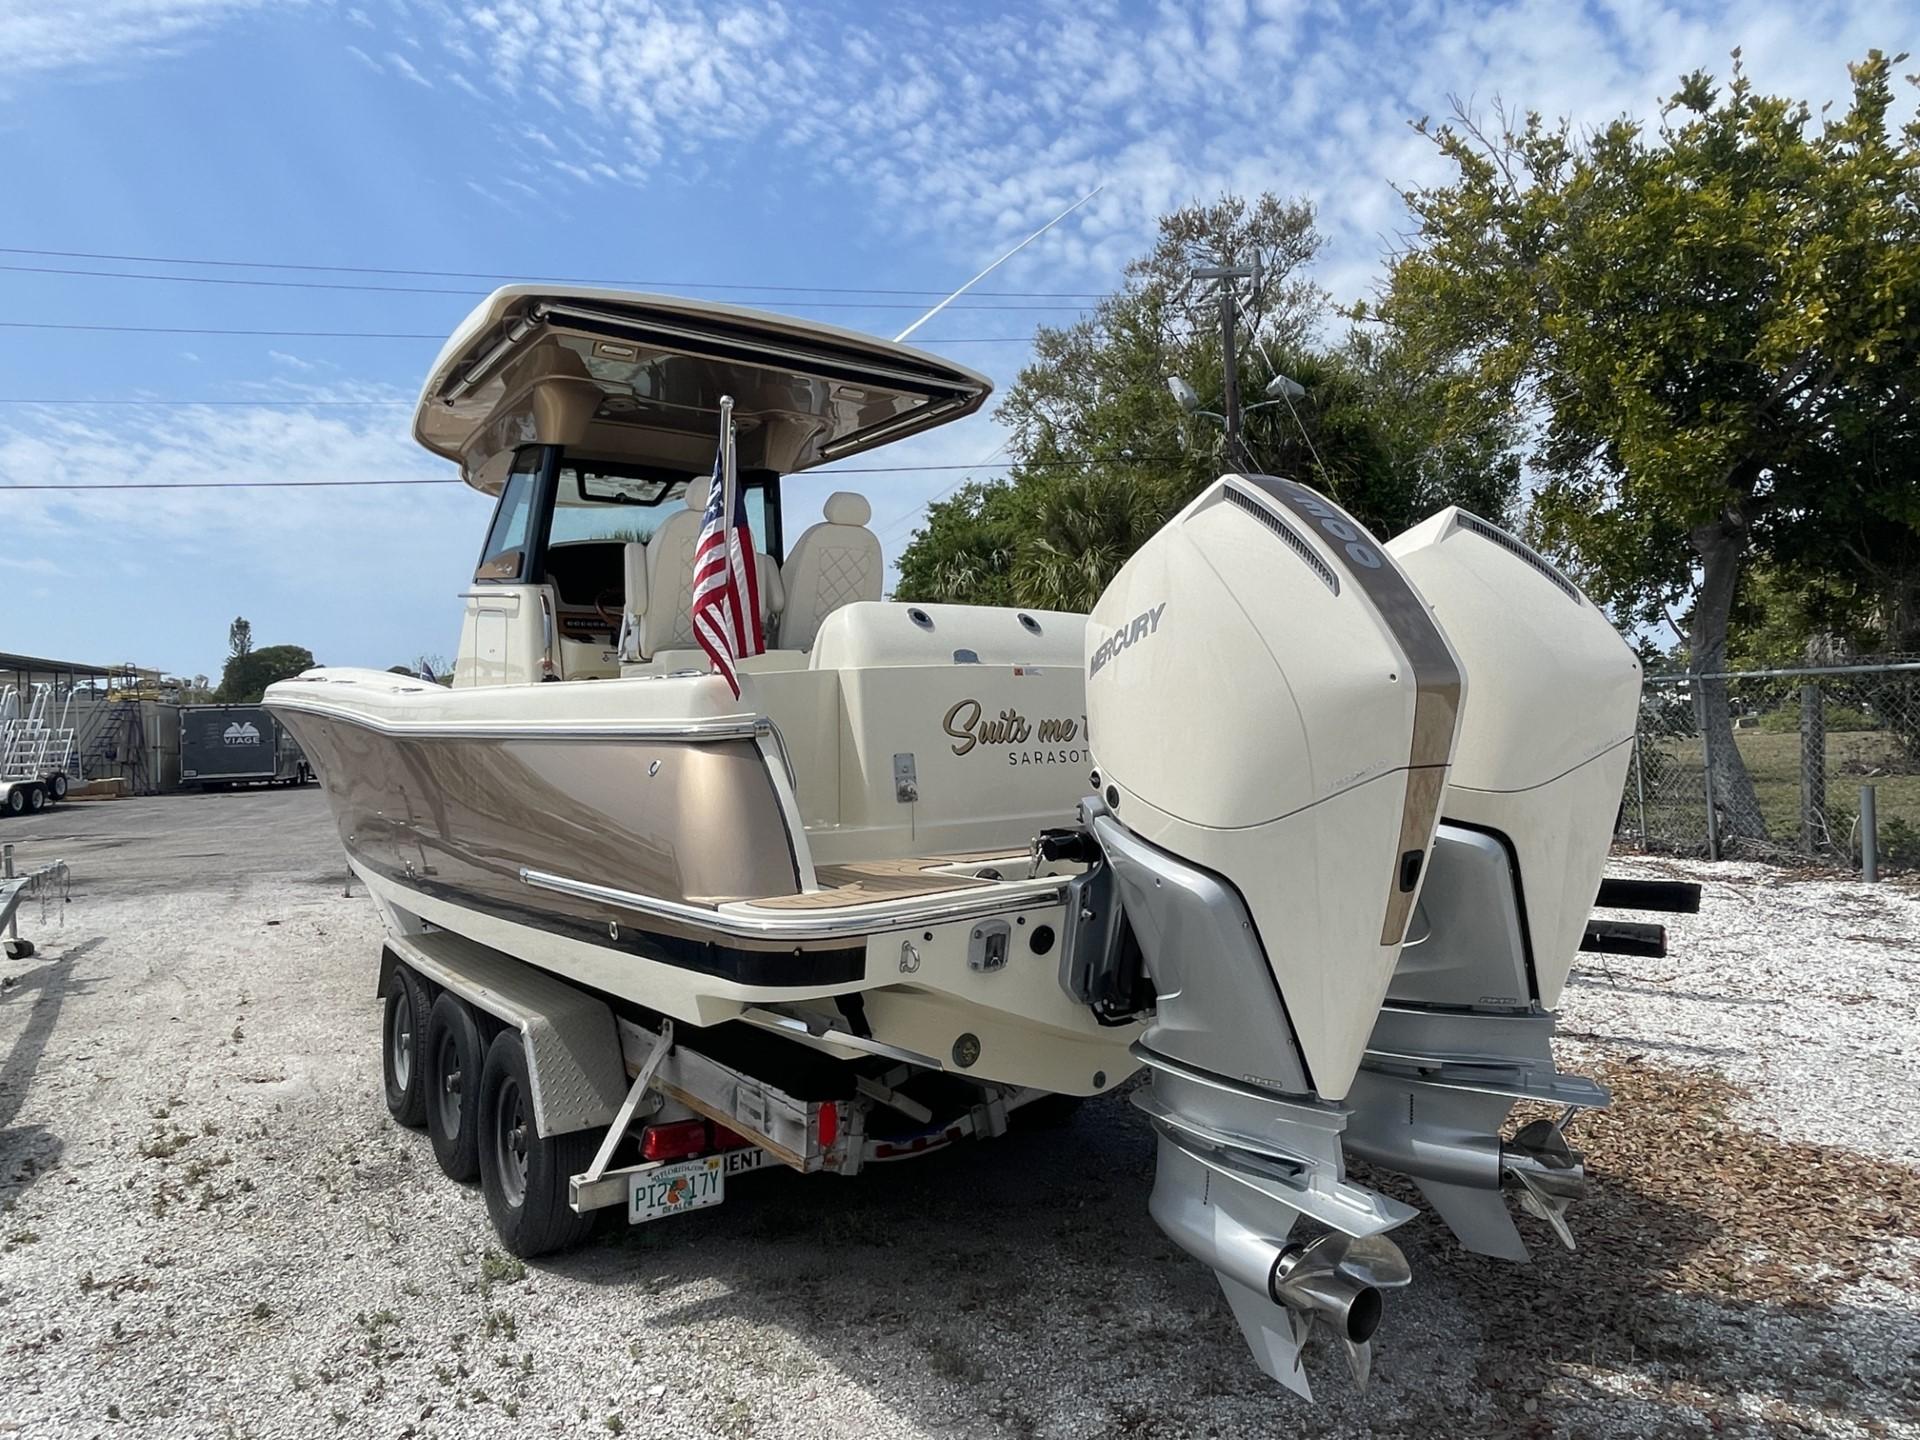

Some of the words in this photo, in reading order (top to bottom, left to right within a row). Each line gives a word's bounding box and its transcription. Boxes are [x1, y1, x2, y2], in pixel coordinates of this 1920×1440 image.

[1089, 602, 1166, 680] MERCURY
[224, 736, 260, 745] VIAGE
[943, 699, 1032, 756] Suits
[1037, 718, 1078, 743] me
[635, 1182, 668, 1212] PI2
[689, 1169, 719, 1199] 17Y
